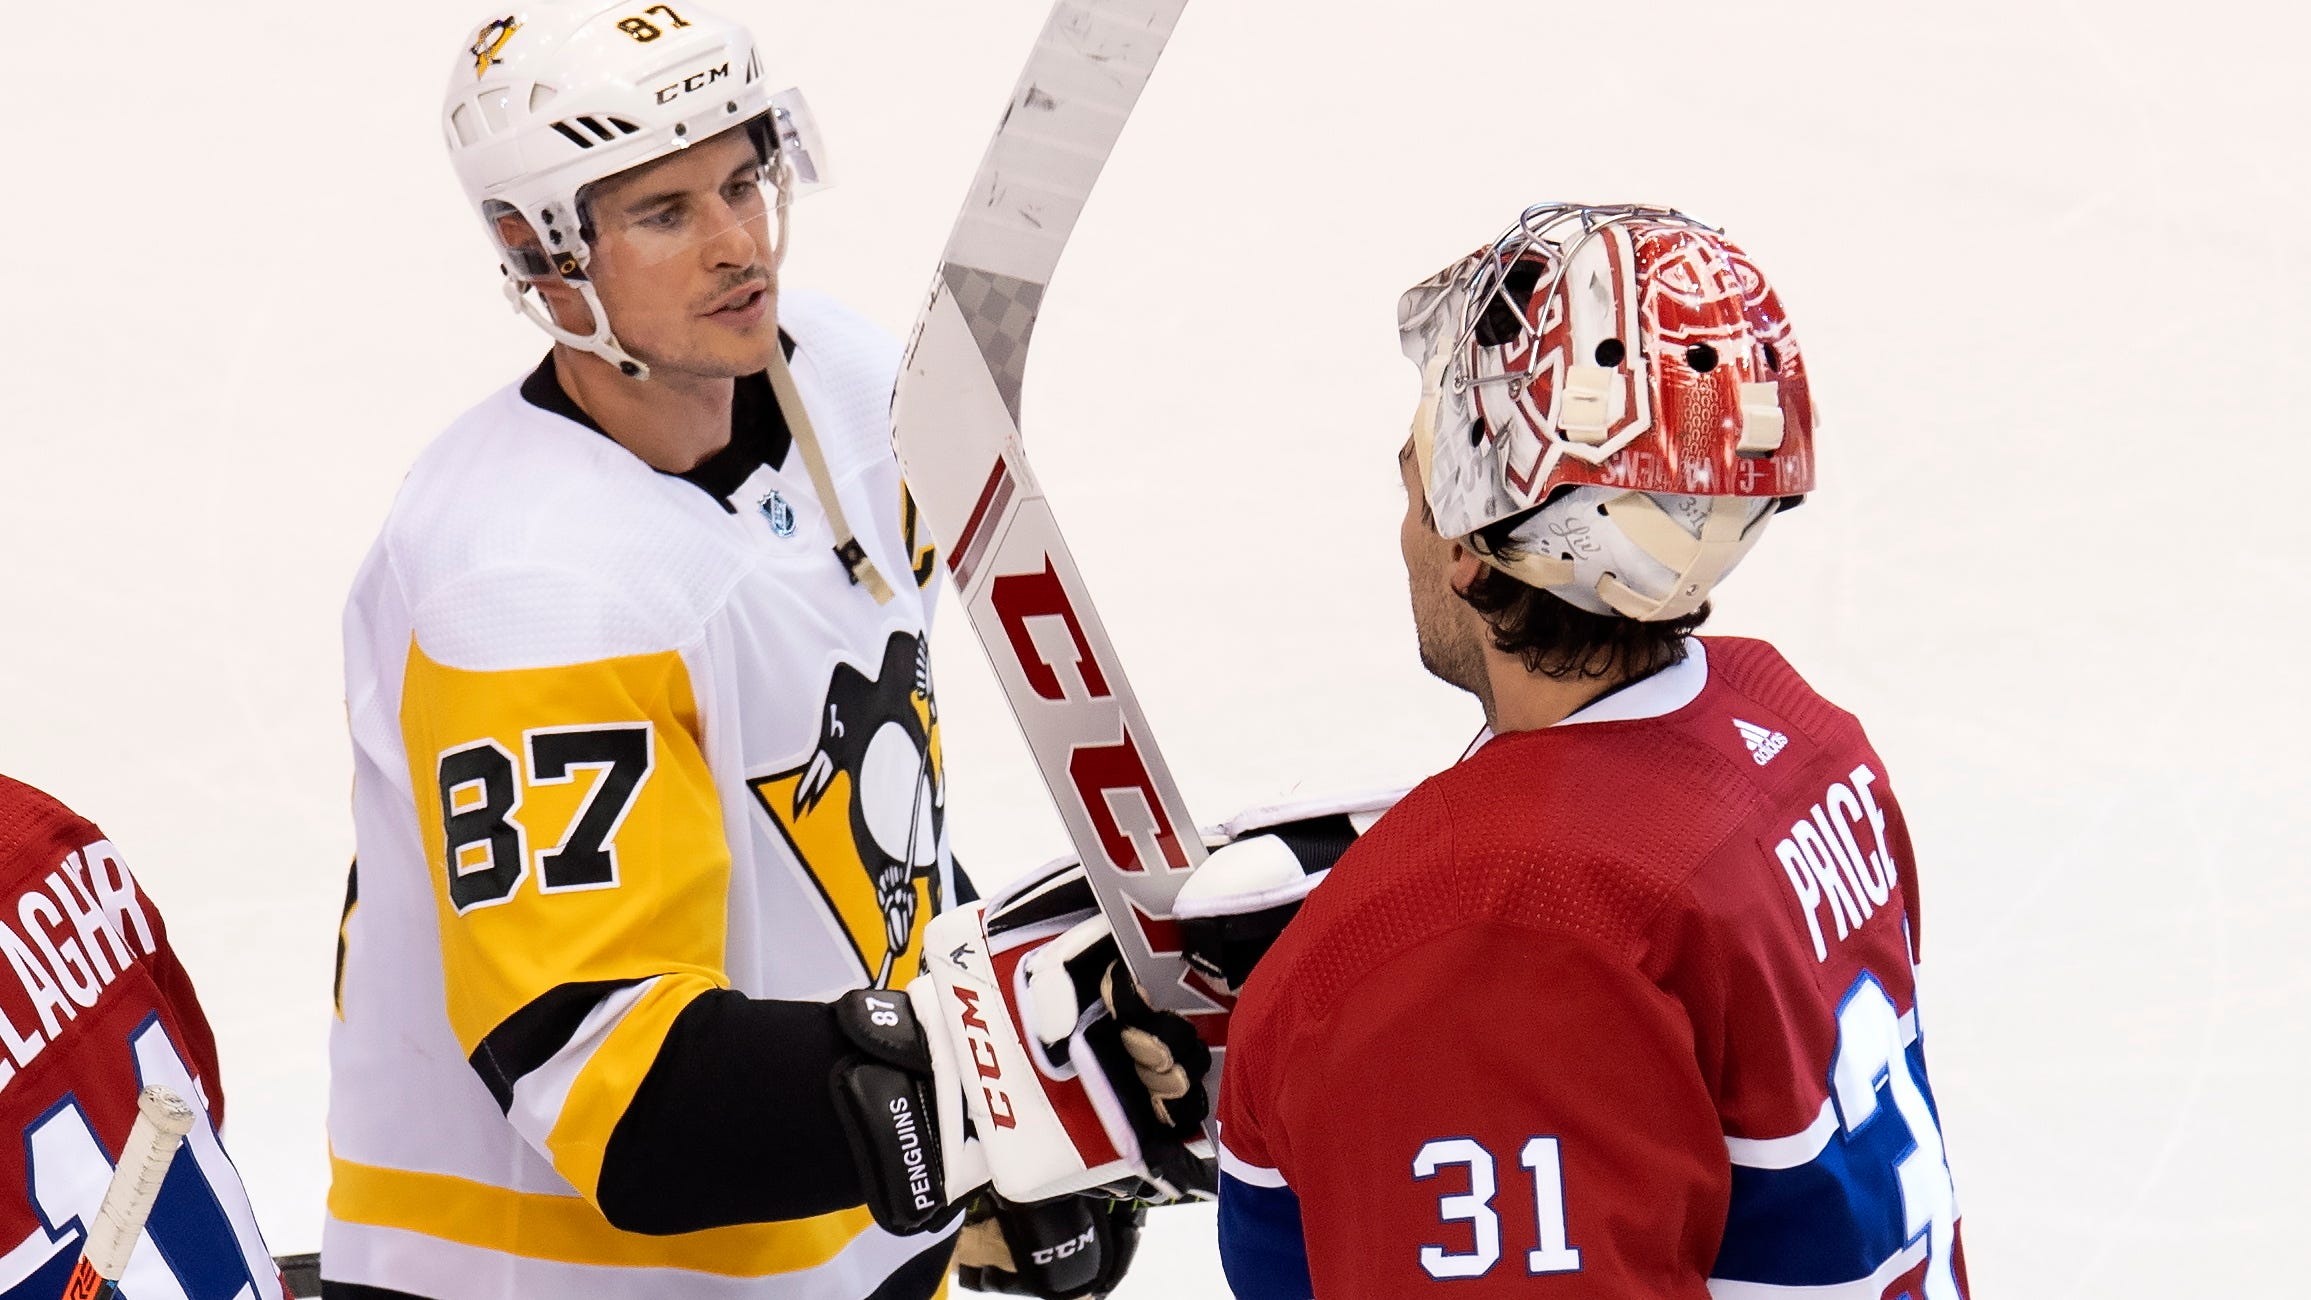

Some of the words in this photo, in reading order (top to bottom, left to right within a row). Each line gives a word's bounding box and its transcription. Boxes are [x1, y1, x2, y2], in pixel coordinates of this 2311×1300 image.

[617, 4, 692, 43] 87
[655, 62, 729, 105] CCM
[437, 720, 655, 918] 87
[1775, 765, 1897, 963] PRICE
[0, 839, 157, 1093] LAGHR
[865, 996, 899, 1027] 87
[952, 984, 1017, 1131] CCM
[1828, 910, 1970, 1300] 3
[889, 1096, 935, 1211] PENGUINS
[1411, 1134, 1584, 1282] 31
[1031, 1225, 1095, 1265] CCM
